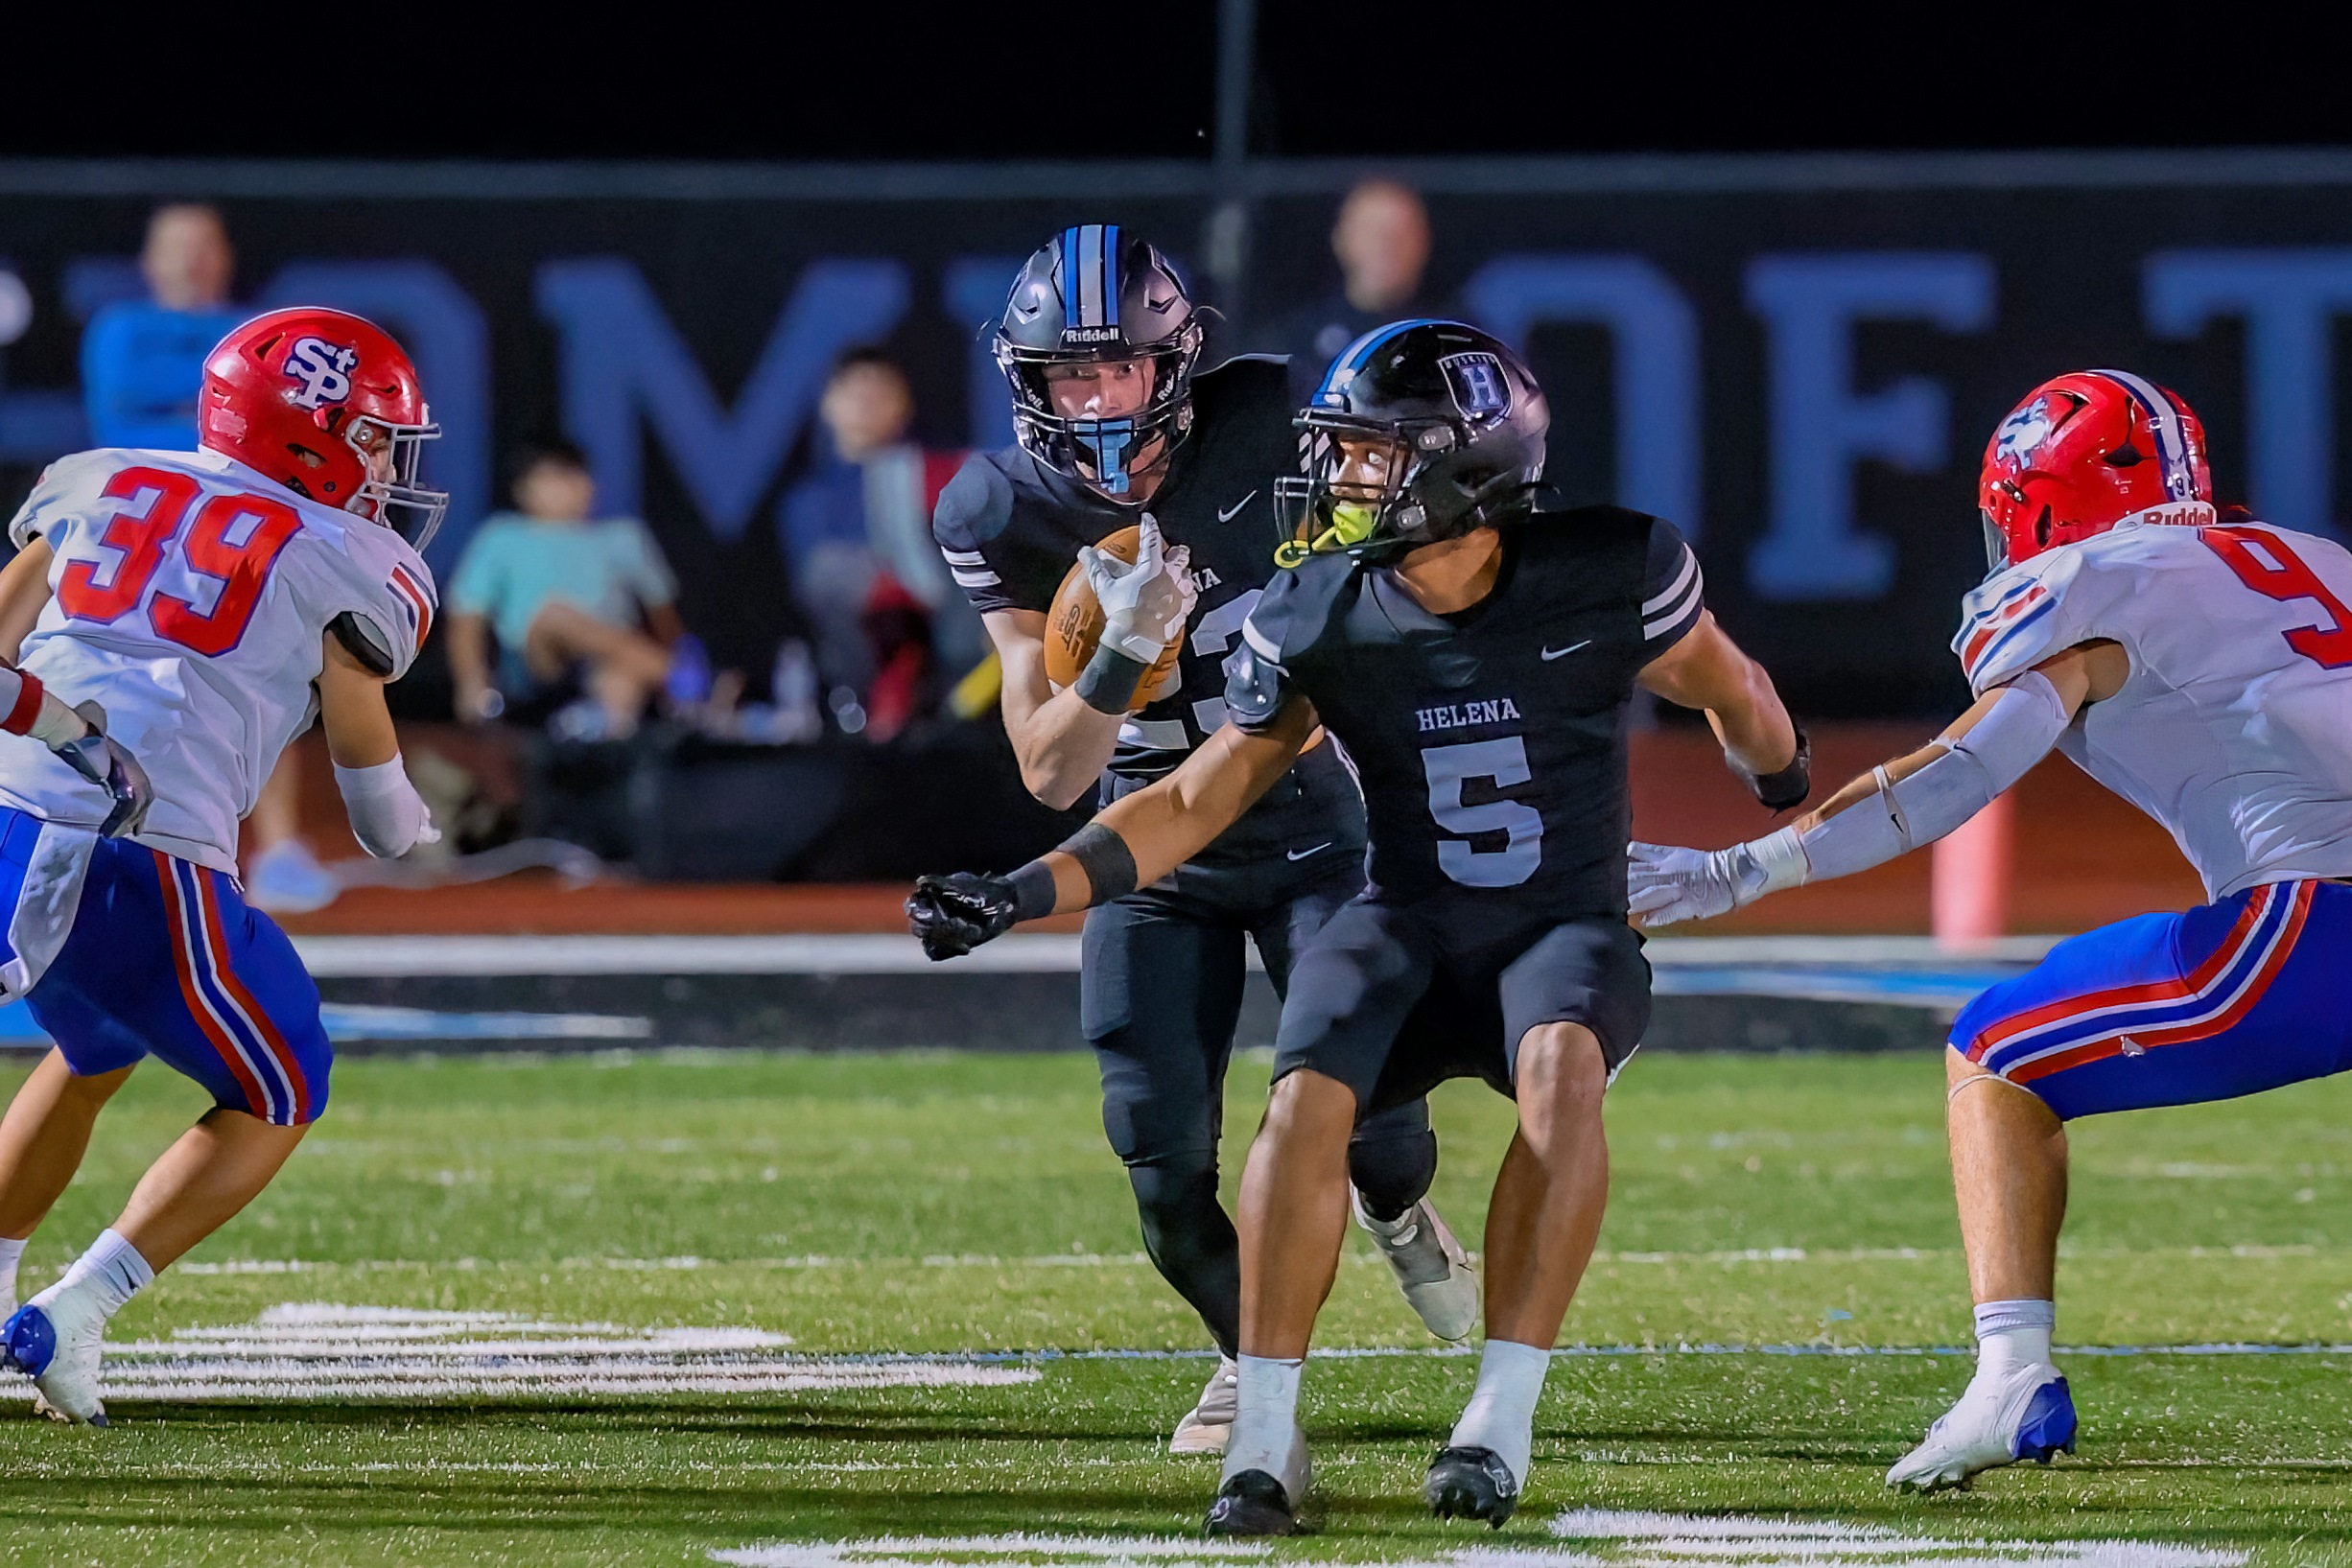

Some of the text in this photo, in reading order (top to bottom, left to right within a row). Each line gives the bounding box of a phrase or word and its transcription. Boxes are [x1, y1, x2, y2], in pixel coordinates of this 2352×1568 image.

[1066, 327, 1119, 342] Riddell
[1461, 366, 1503, 408] H
[2176, 477, 2185, 497] 9
[57, 466, 305, 658] 39
[2197, 526, 2352, 670] 9
[1415, 697, 1521, 732] HELENA
[1420, 735, 1544, 888] 5
